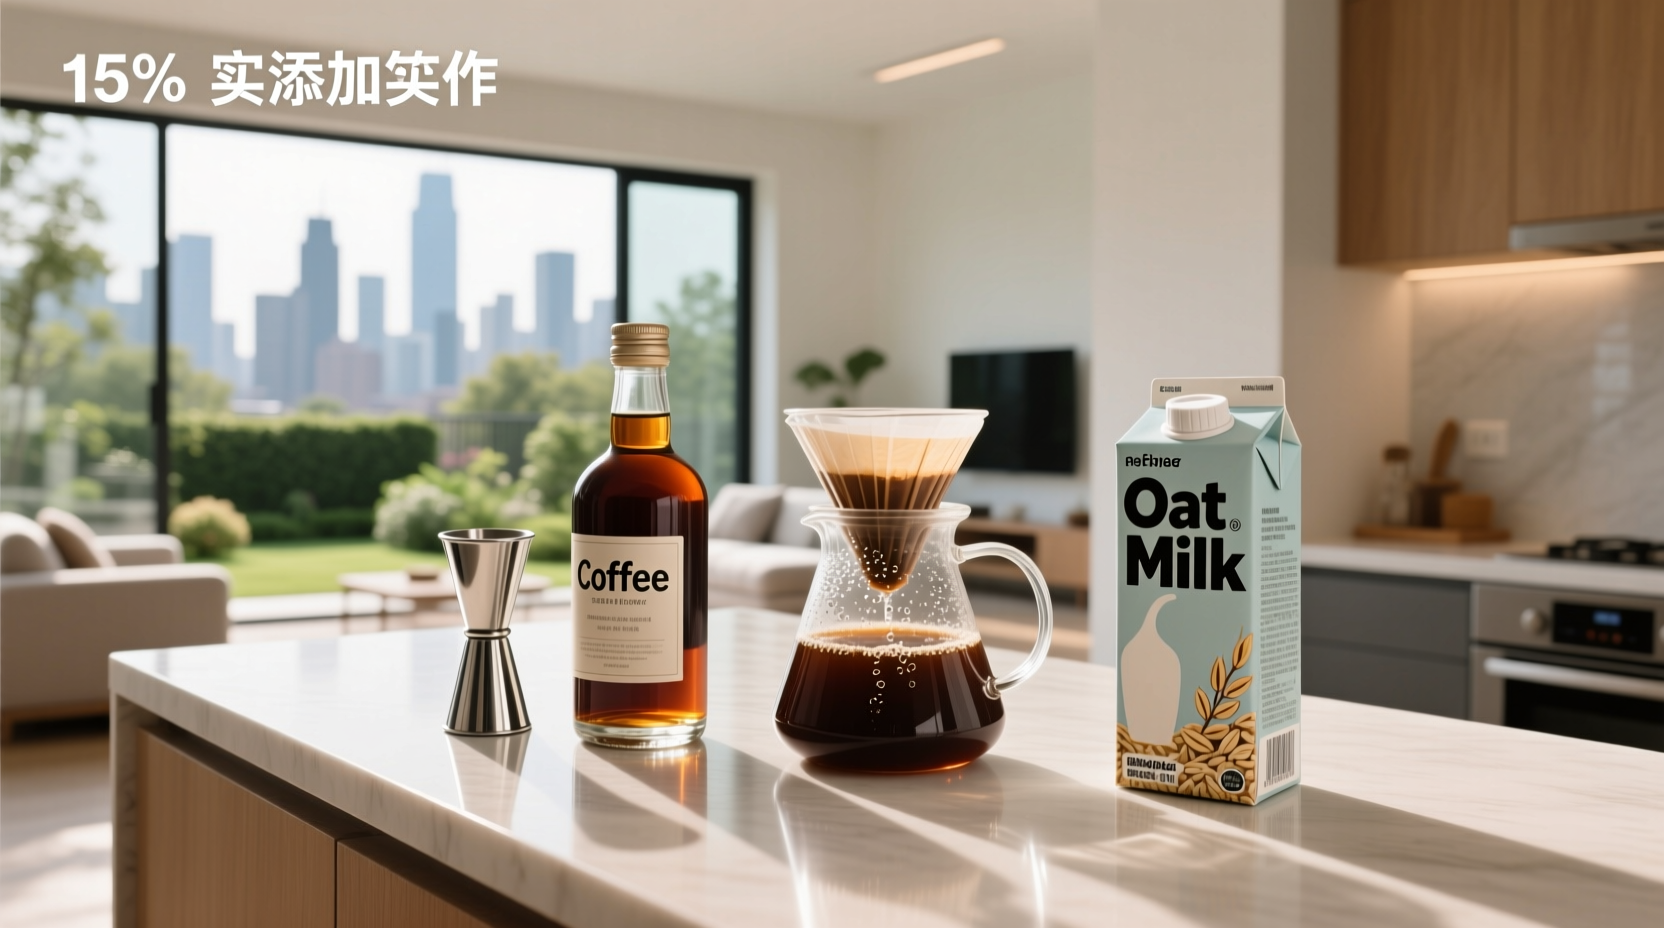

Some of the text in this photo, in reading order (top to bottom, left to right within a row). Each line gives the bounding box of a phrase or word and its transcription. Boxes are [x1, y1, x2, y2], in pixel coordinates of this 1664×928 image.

[1124, 477, 1226, 530] Oat
[578, 559, 669, 592] Coffee
[1126, 535, 1246, 592] Milk
